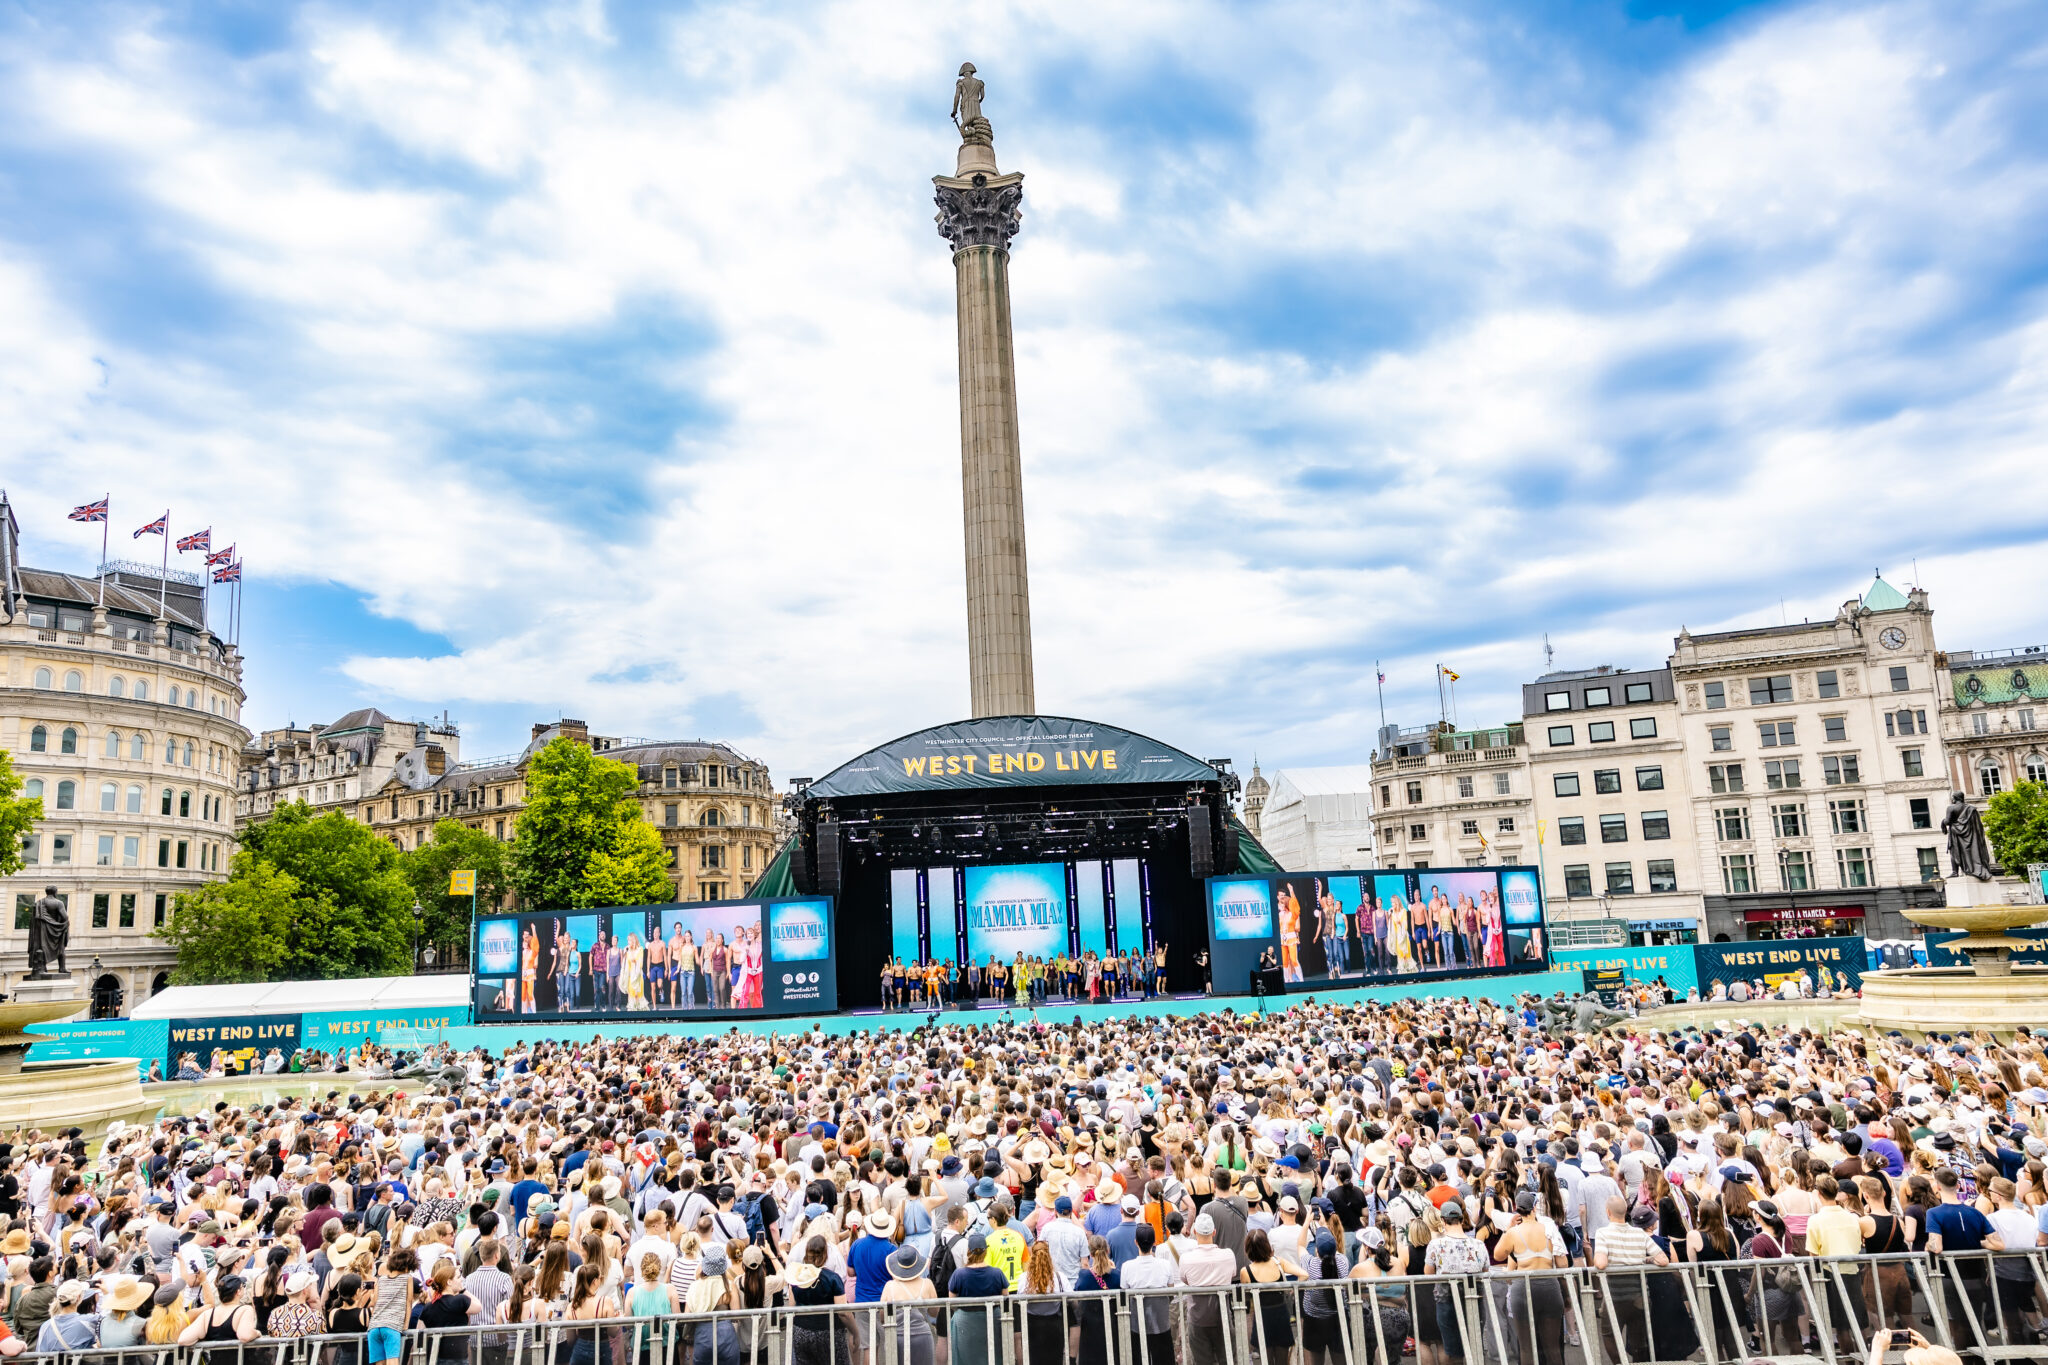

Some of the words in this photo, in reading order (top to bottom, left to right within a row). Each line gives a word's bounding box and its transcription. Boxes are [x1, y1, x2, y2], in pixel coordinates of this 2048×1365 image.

[1701, 641, 1769, 656] CANADIAN
[1778, 634, 1833, 647] PACIFIC
[903, 755, 977, 777] WEST
[988, 752, 1046, 773] END
[1055, 749, 1118, 771] LIVE
[970, 904, 1027, 928] MAMMA
[1030, 901, 1063, 925] MIA!
[1215, 903, 1248, 918] MAMMA
[1250, 902, 1269, 916] MIA!
[1781, 910, 1795, 919] PRET
[1802, 908, 1827, 918] MANGER
[772, 925, 805, 939] MAMMA
[807, 923, 826, 937] MIA!
[1629, 921, 1652, 930] AFFÈ
[1656, 921, 1684, 929] NERO
[1549, 961, 1590, 972] WEST
[1596, 958, 1628, 970] END
[1633, 957, 1668, 970] LIVE
[1721, 951, 1764, 966] WEST
[1769, 950, 1801, 963] END
[1805, 948, 1841, 961] LIVE
[172, 1028, 216, 1042] WEST
[221, 1026, 253, 1040] END
[259, 1024, 295, 1038] LIVE
[328, 1021, 370, 1035] WEST
[376, 1019, 409, 1032] END
[414, 1017, 450, 1029] LIVE
